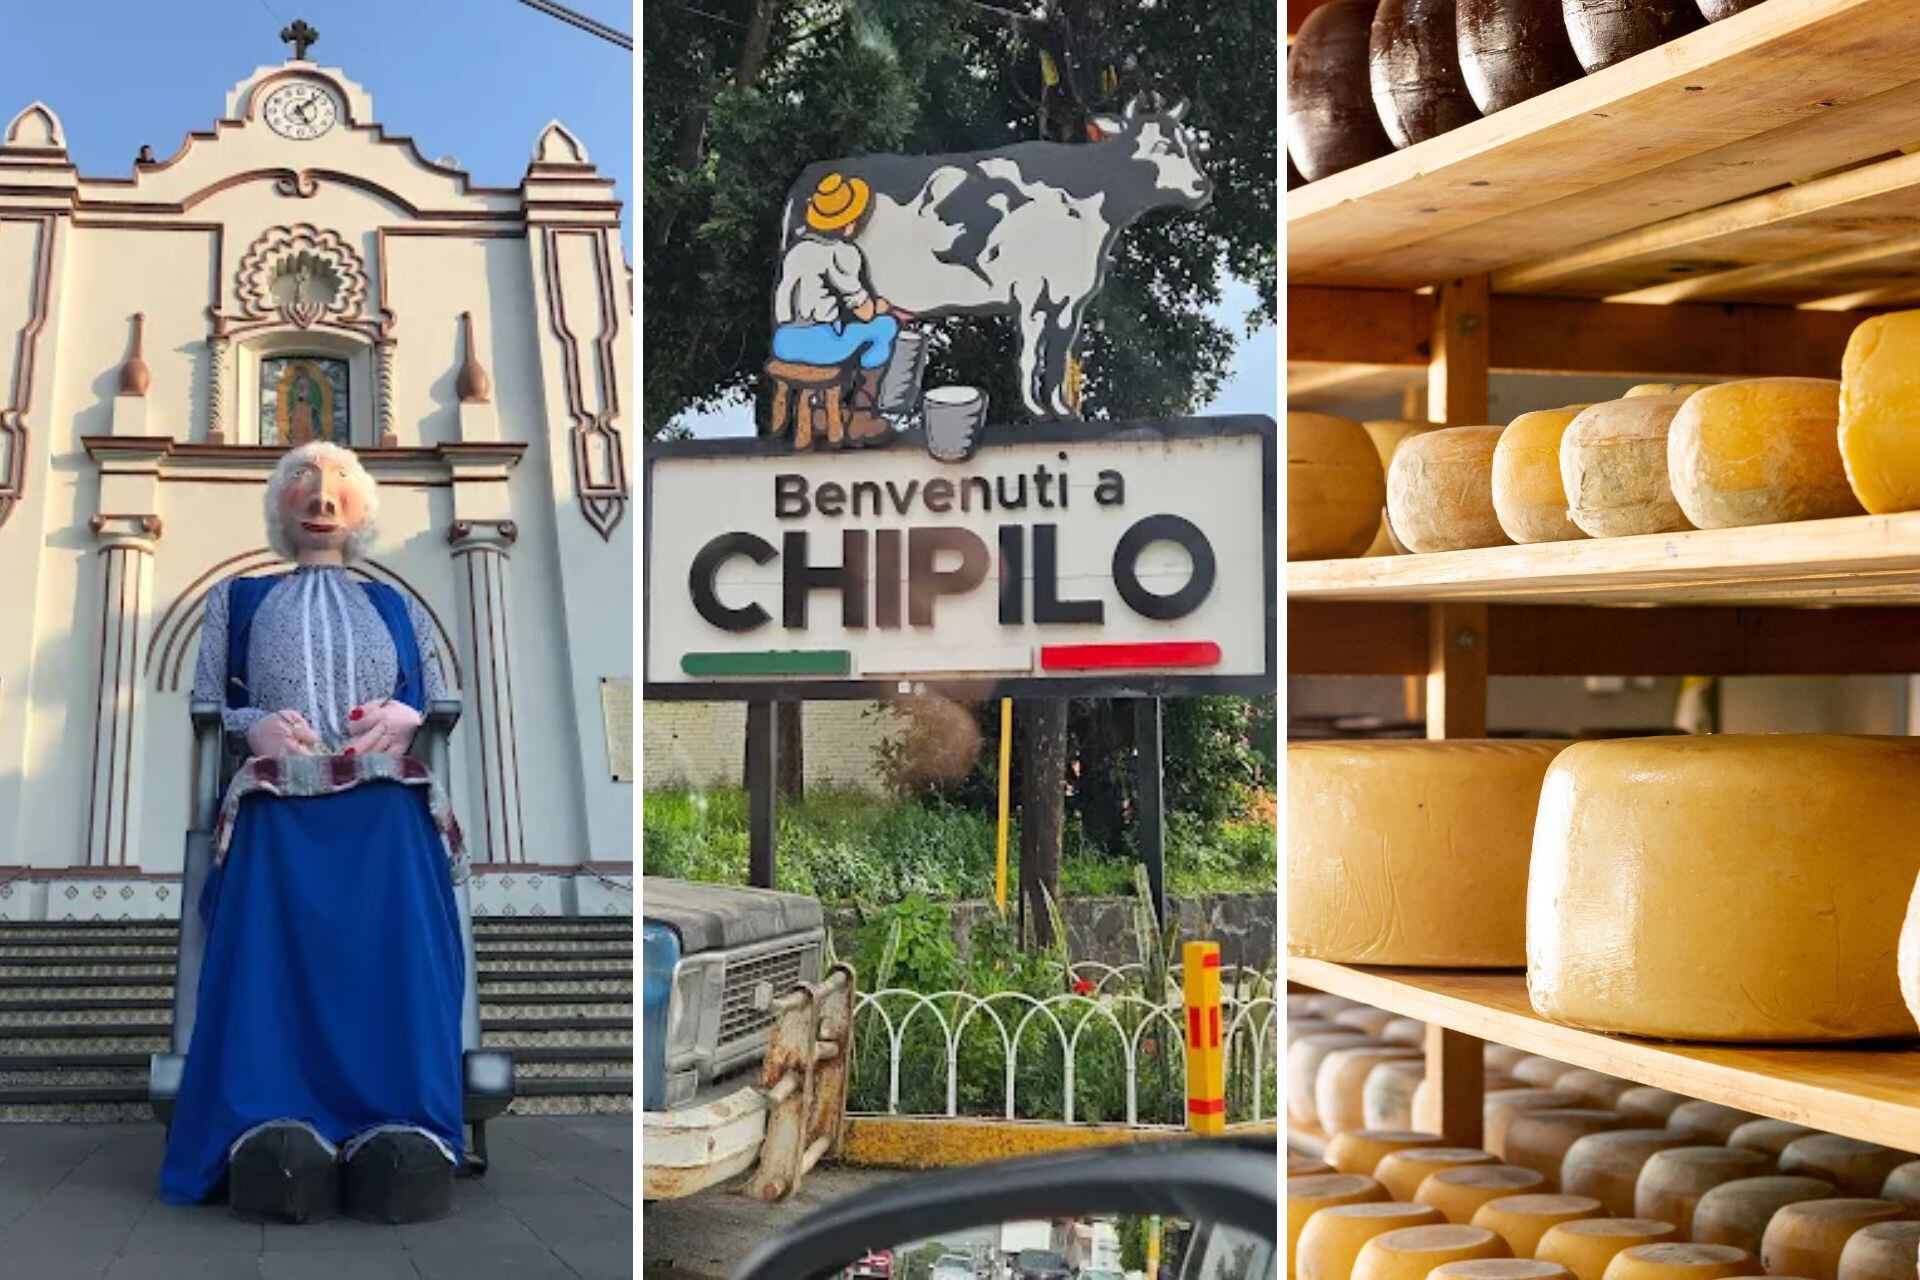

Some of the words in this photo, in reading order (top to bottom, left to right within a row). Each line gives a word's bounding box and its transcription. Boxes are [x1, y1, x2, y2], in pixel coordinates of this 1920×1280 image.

[775, 452, 1069, 518] Benvenuti
[1094, 468, 1125, 505] a
[688, 513, 1216, 633] CHIPILO
